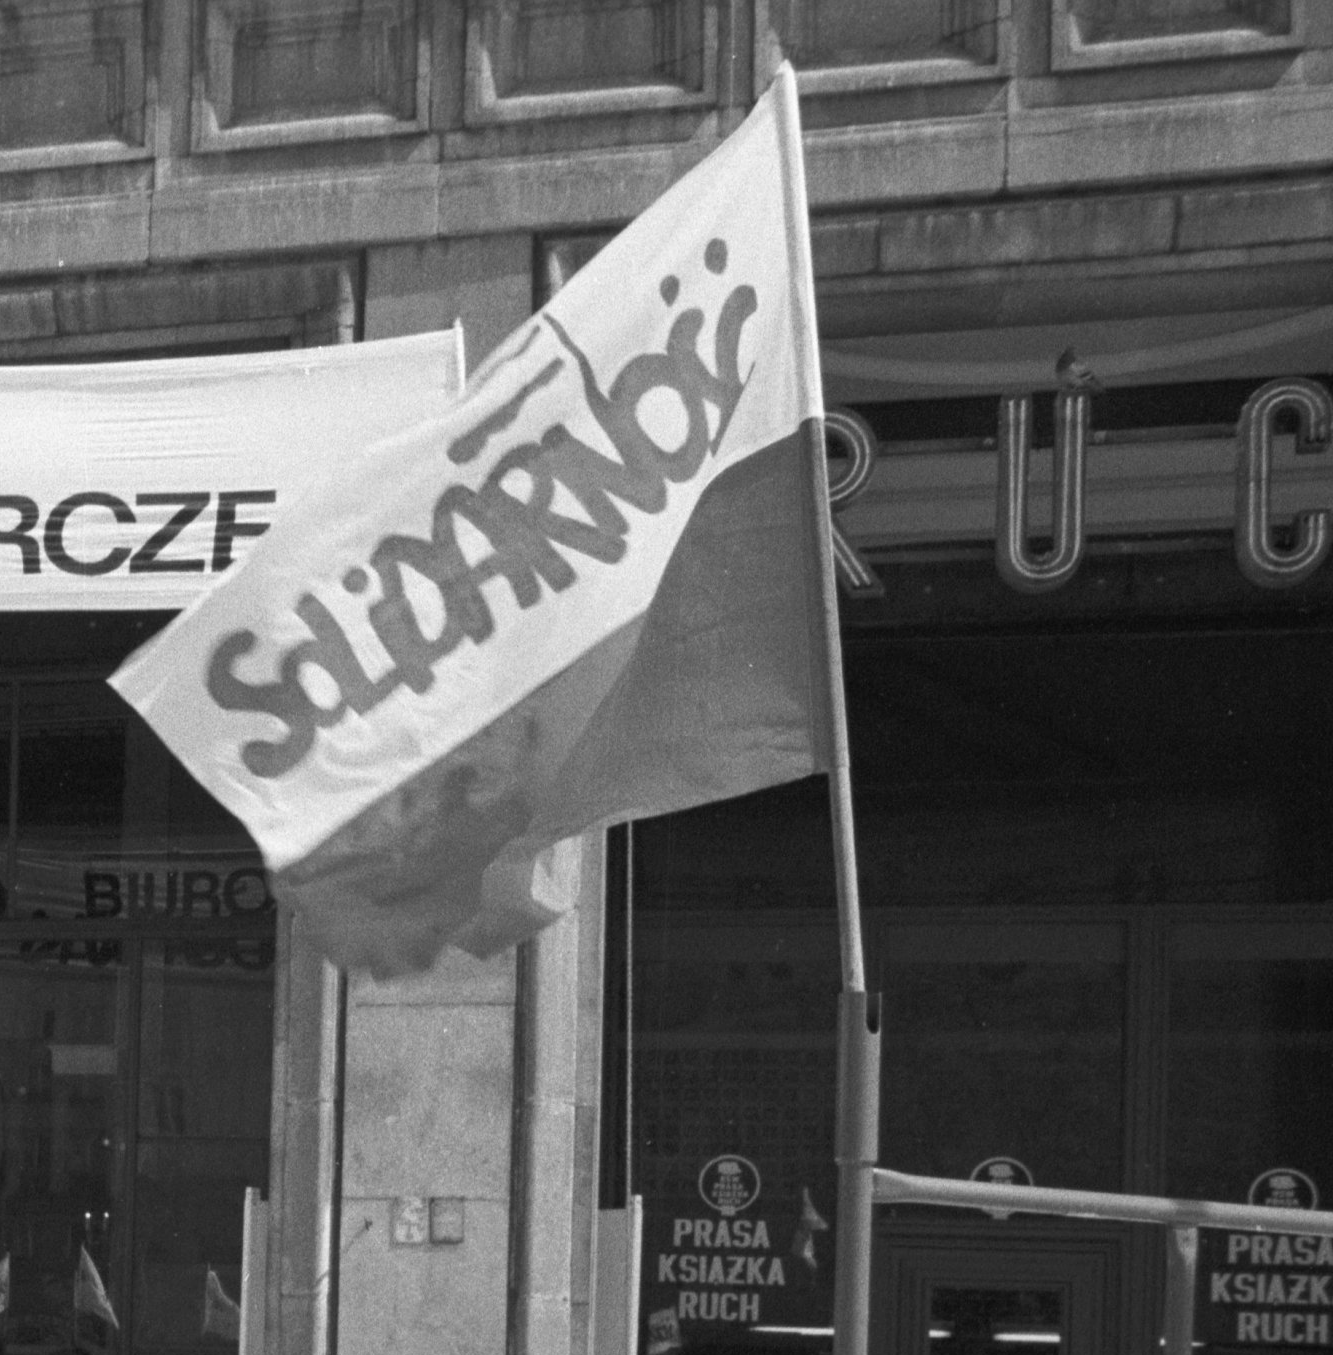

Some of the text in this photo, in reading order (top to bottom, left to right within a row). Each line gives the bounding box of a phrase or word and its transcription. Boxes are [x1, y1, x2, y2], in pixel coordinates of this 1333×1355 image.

[673, 1218, 770, 1248] PRASA
[1228, 1233, 1333, 1265] PRASA
[678, 1291, 760, 1322] RUCH
[1237, 1311, 1330, 1344] RUCH
